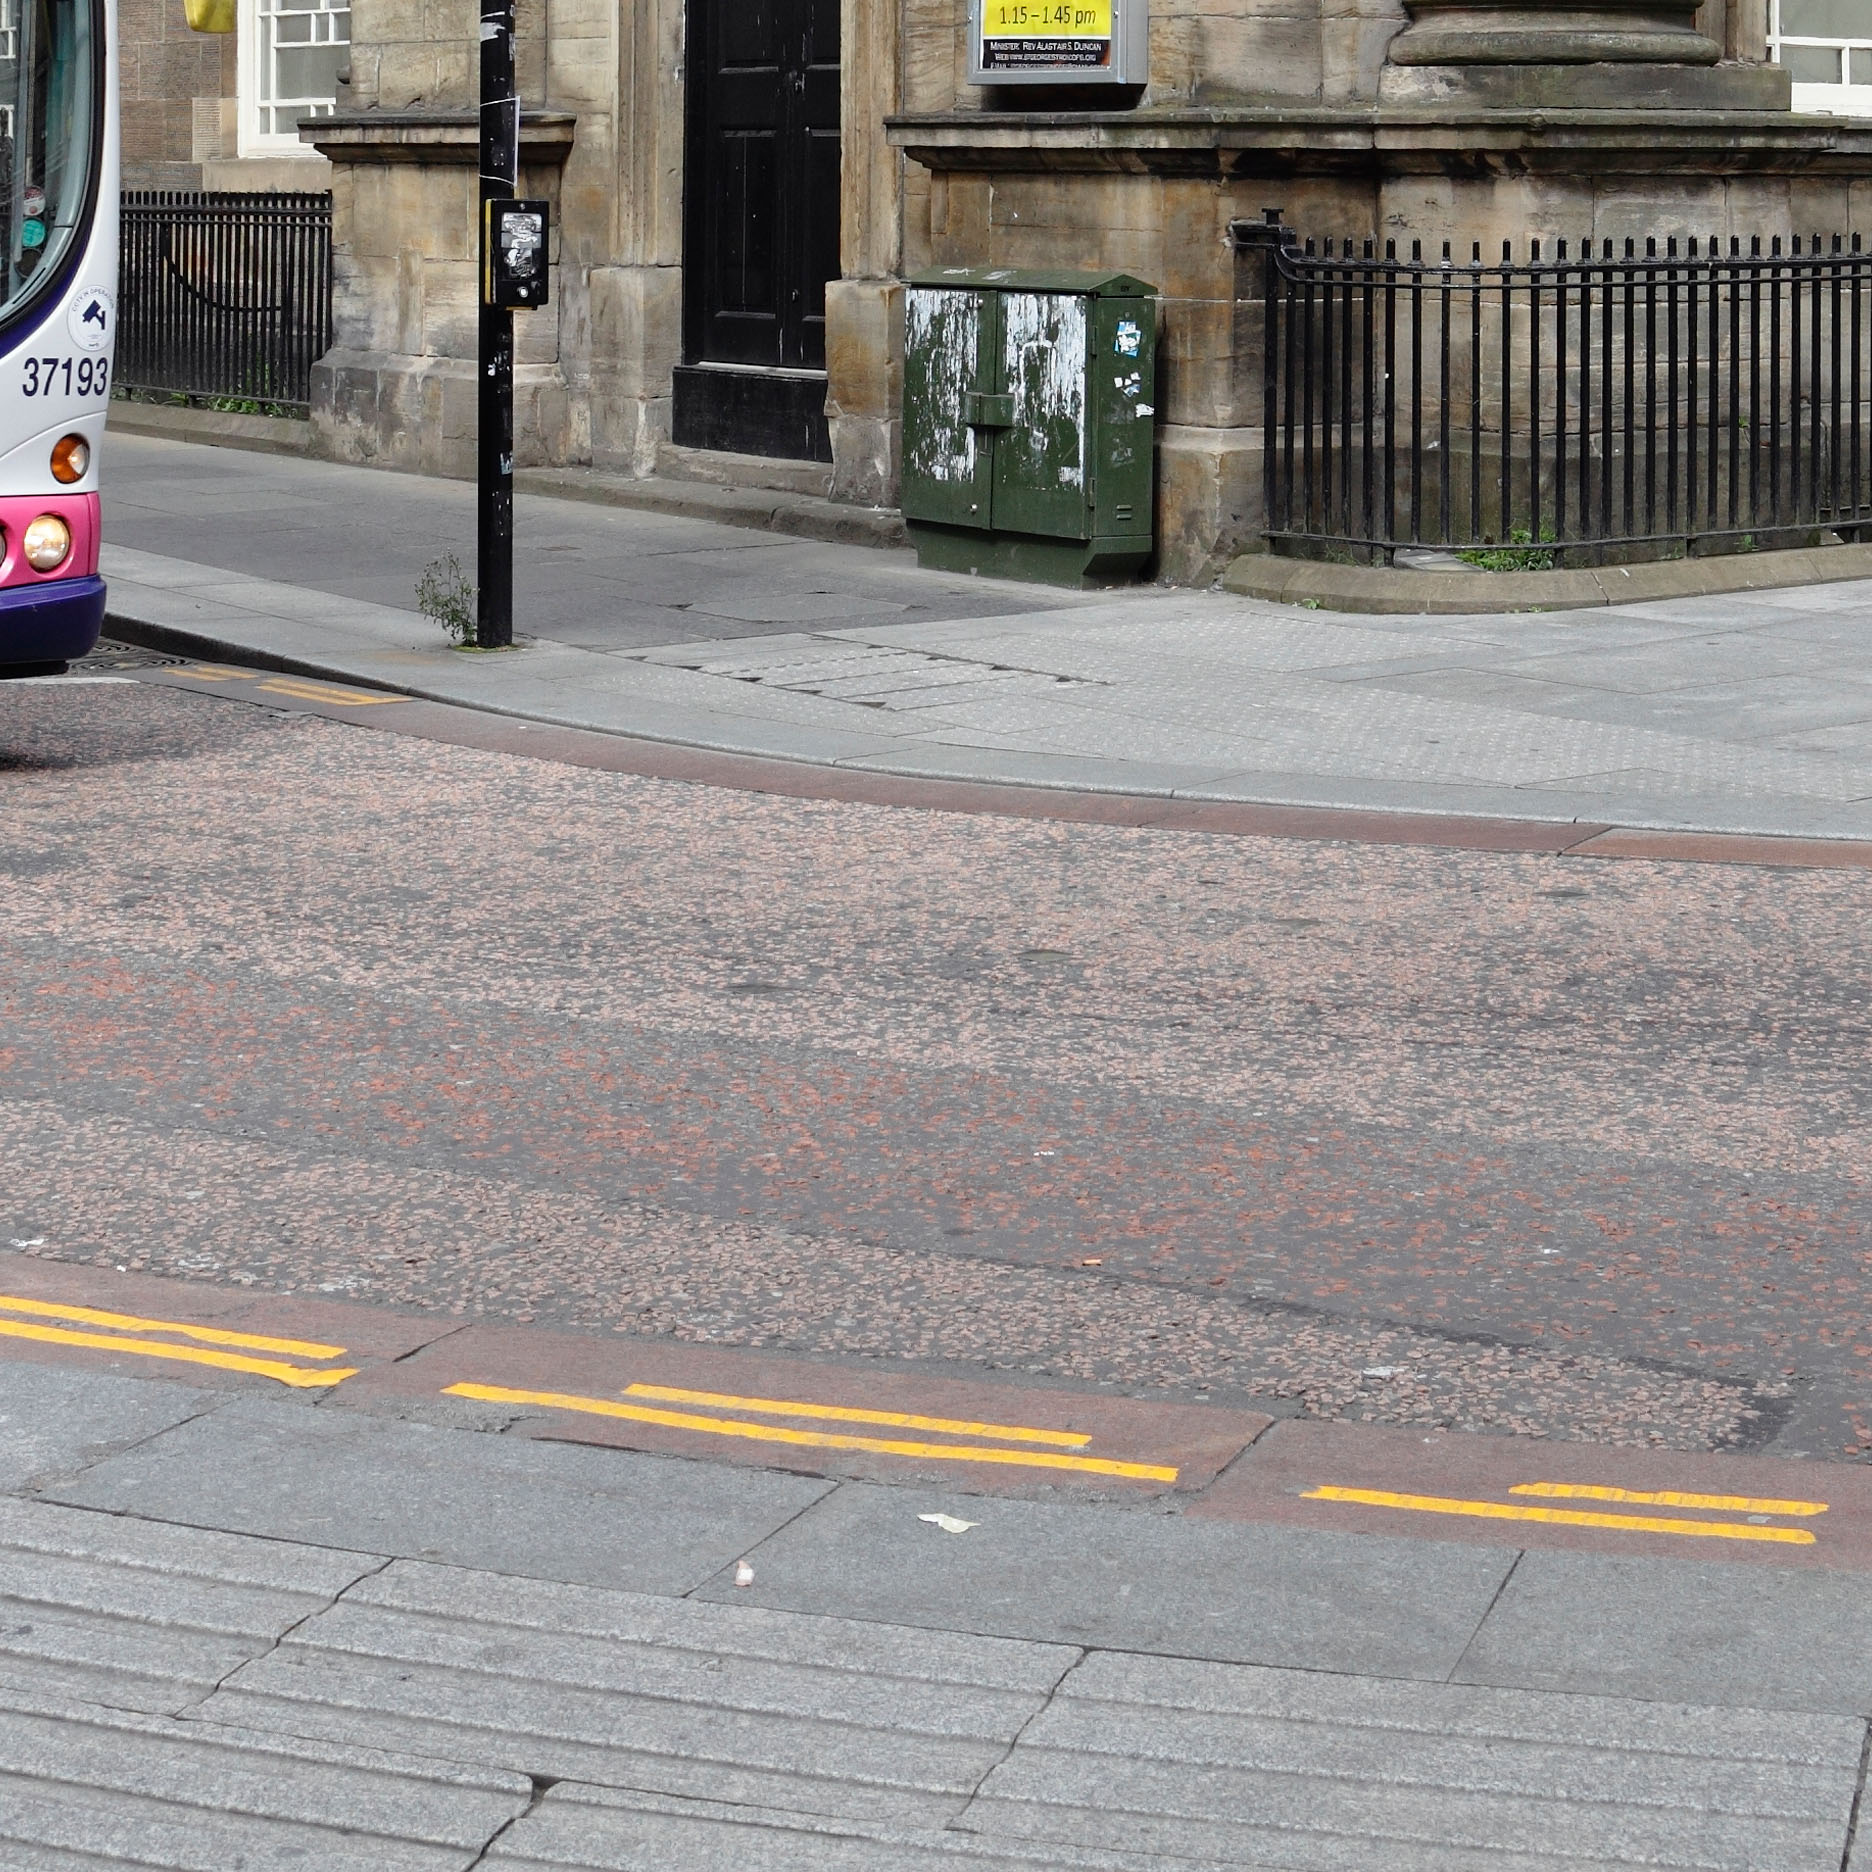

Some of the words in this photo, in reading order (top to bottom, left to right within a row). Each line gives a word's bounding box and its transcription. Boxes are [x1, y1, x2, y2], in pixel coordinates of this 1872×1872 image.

[1000, 6, 1027, 24] 1.15
[1042, 5, 1071, 24] 1.45
[1075, 9, 1096, 28] pm
[22, 357, 109, 397] 37193
